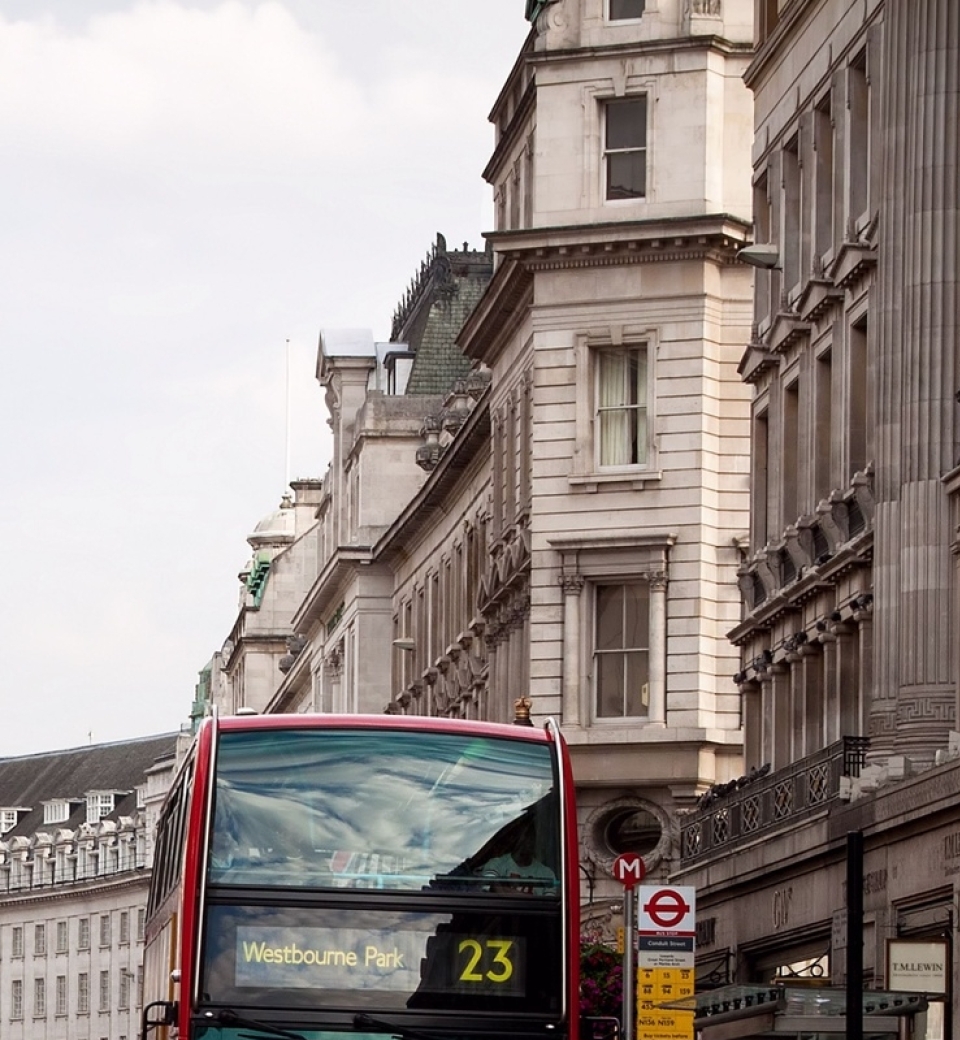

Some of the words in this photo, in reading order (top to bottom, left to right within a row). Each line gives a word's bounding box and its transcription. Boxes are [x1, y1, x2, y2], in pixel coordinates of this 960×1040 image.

[619, 859, 640, 879] M
[243, 941, 357, 967] Westbourne
[365, 946, 403, 969] Park
[458, 939, 513, 983] 23
